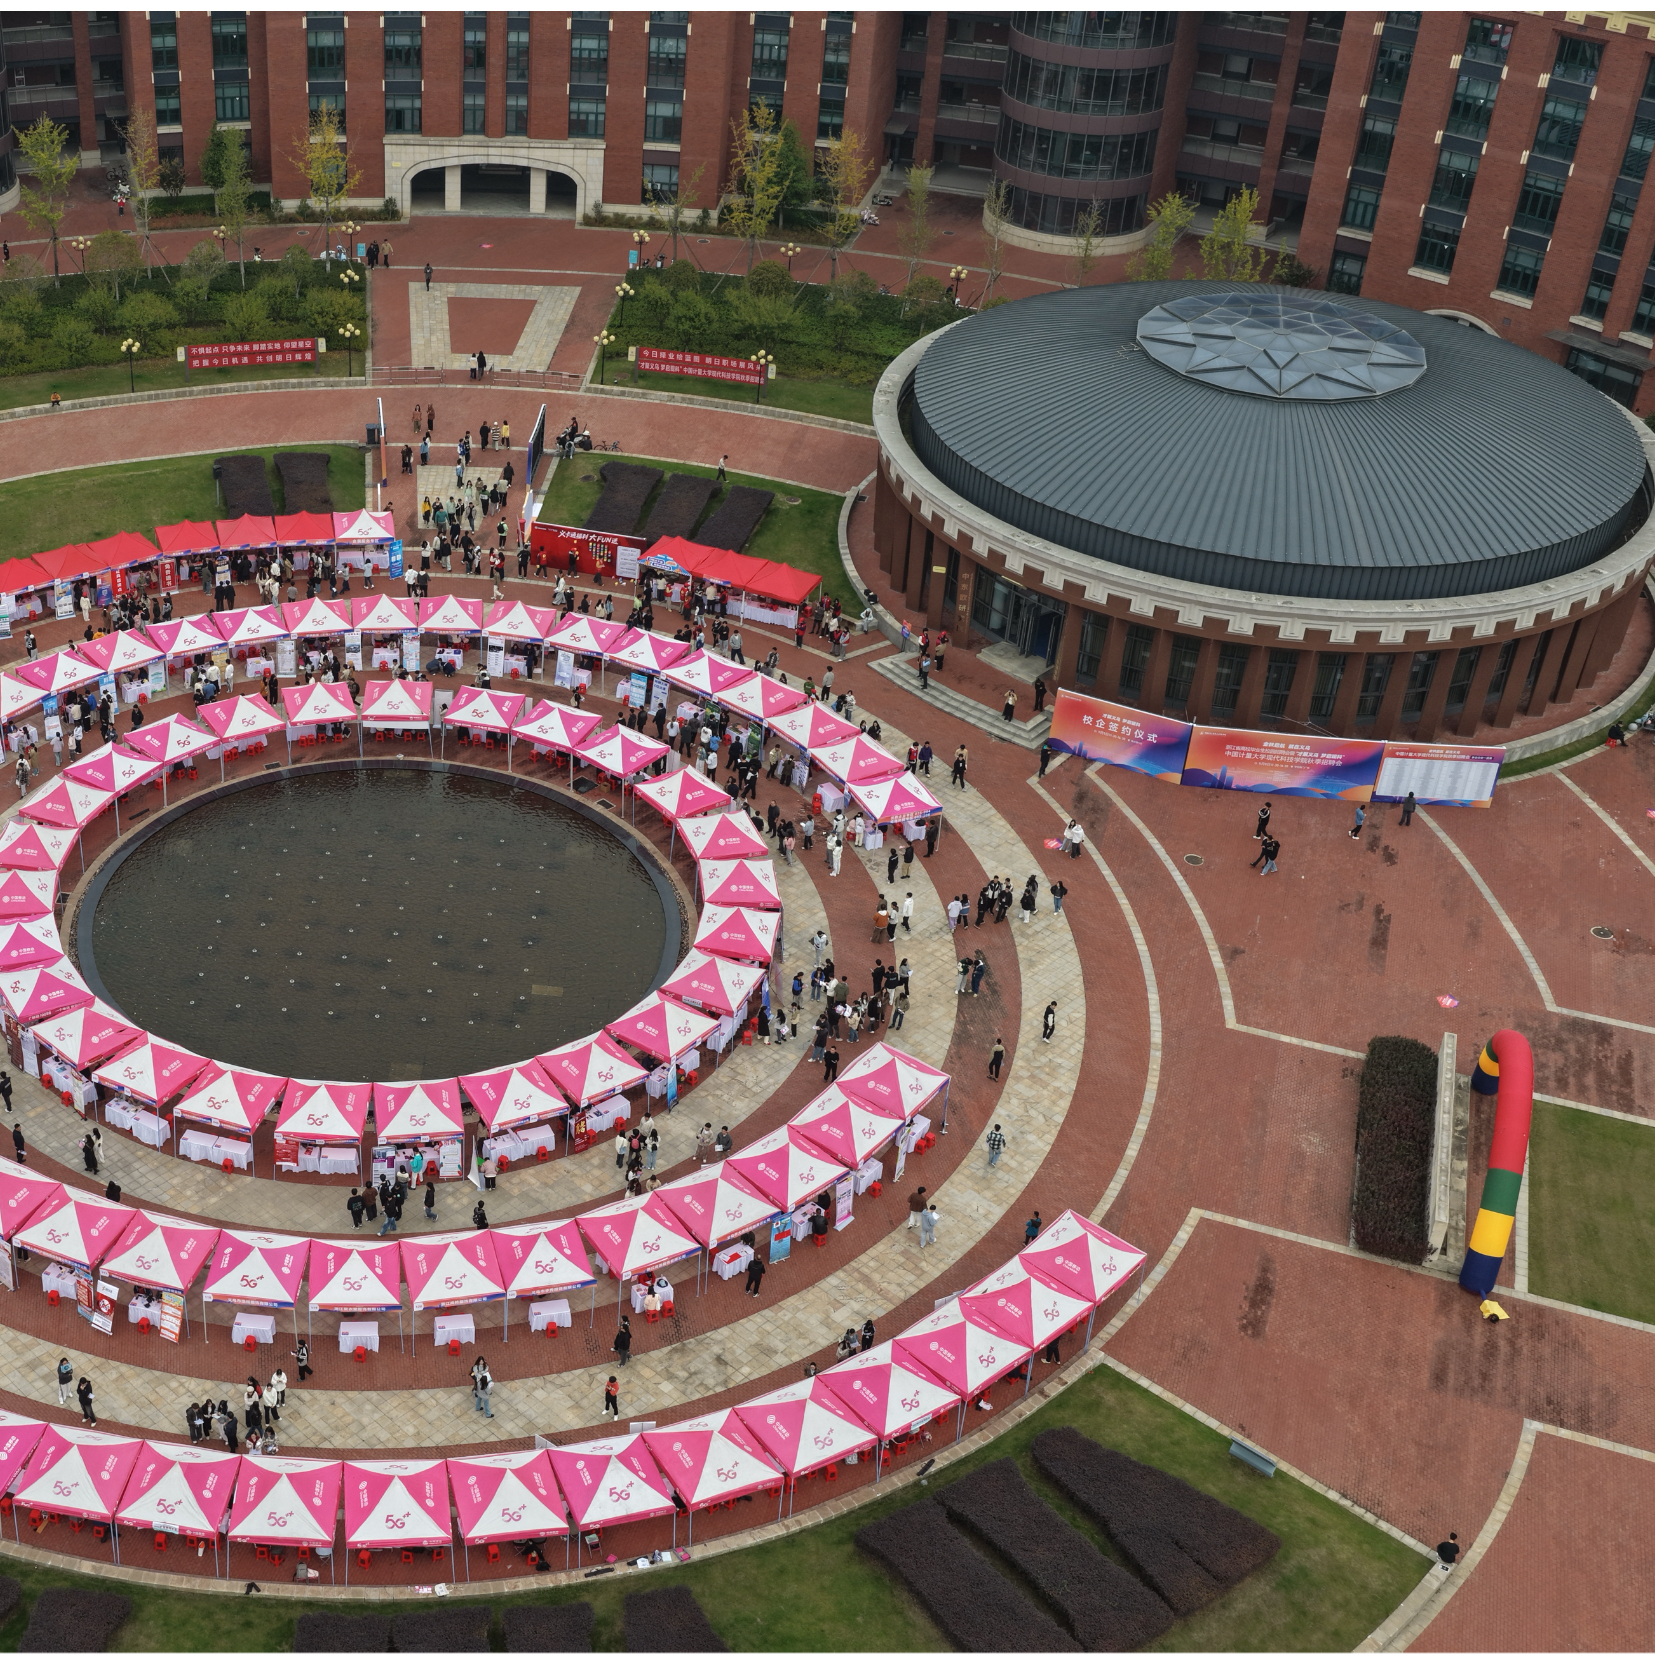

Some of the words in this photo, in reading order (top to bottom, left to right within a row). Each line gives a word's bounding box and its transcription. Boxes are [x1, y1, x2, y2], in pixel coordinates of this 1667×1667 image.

[1082, 714, 1158, 744] 校企签约仪式
